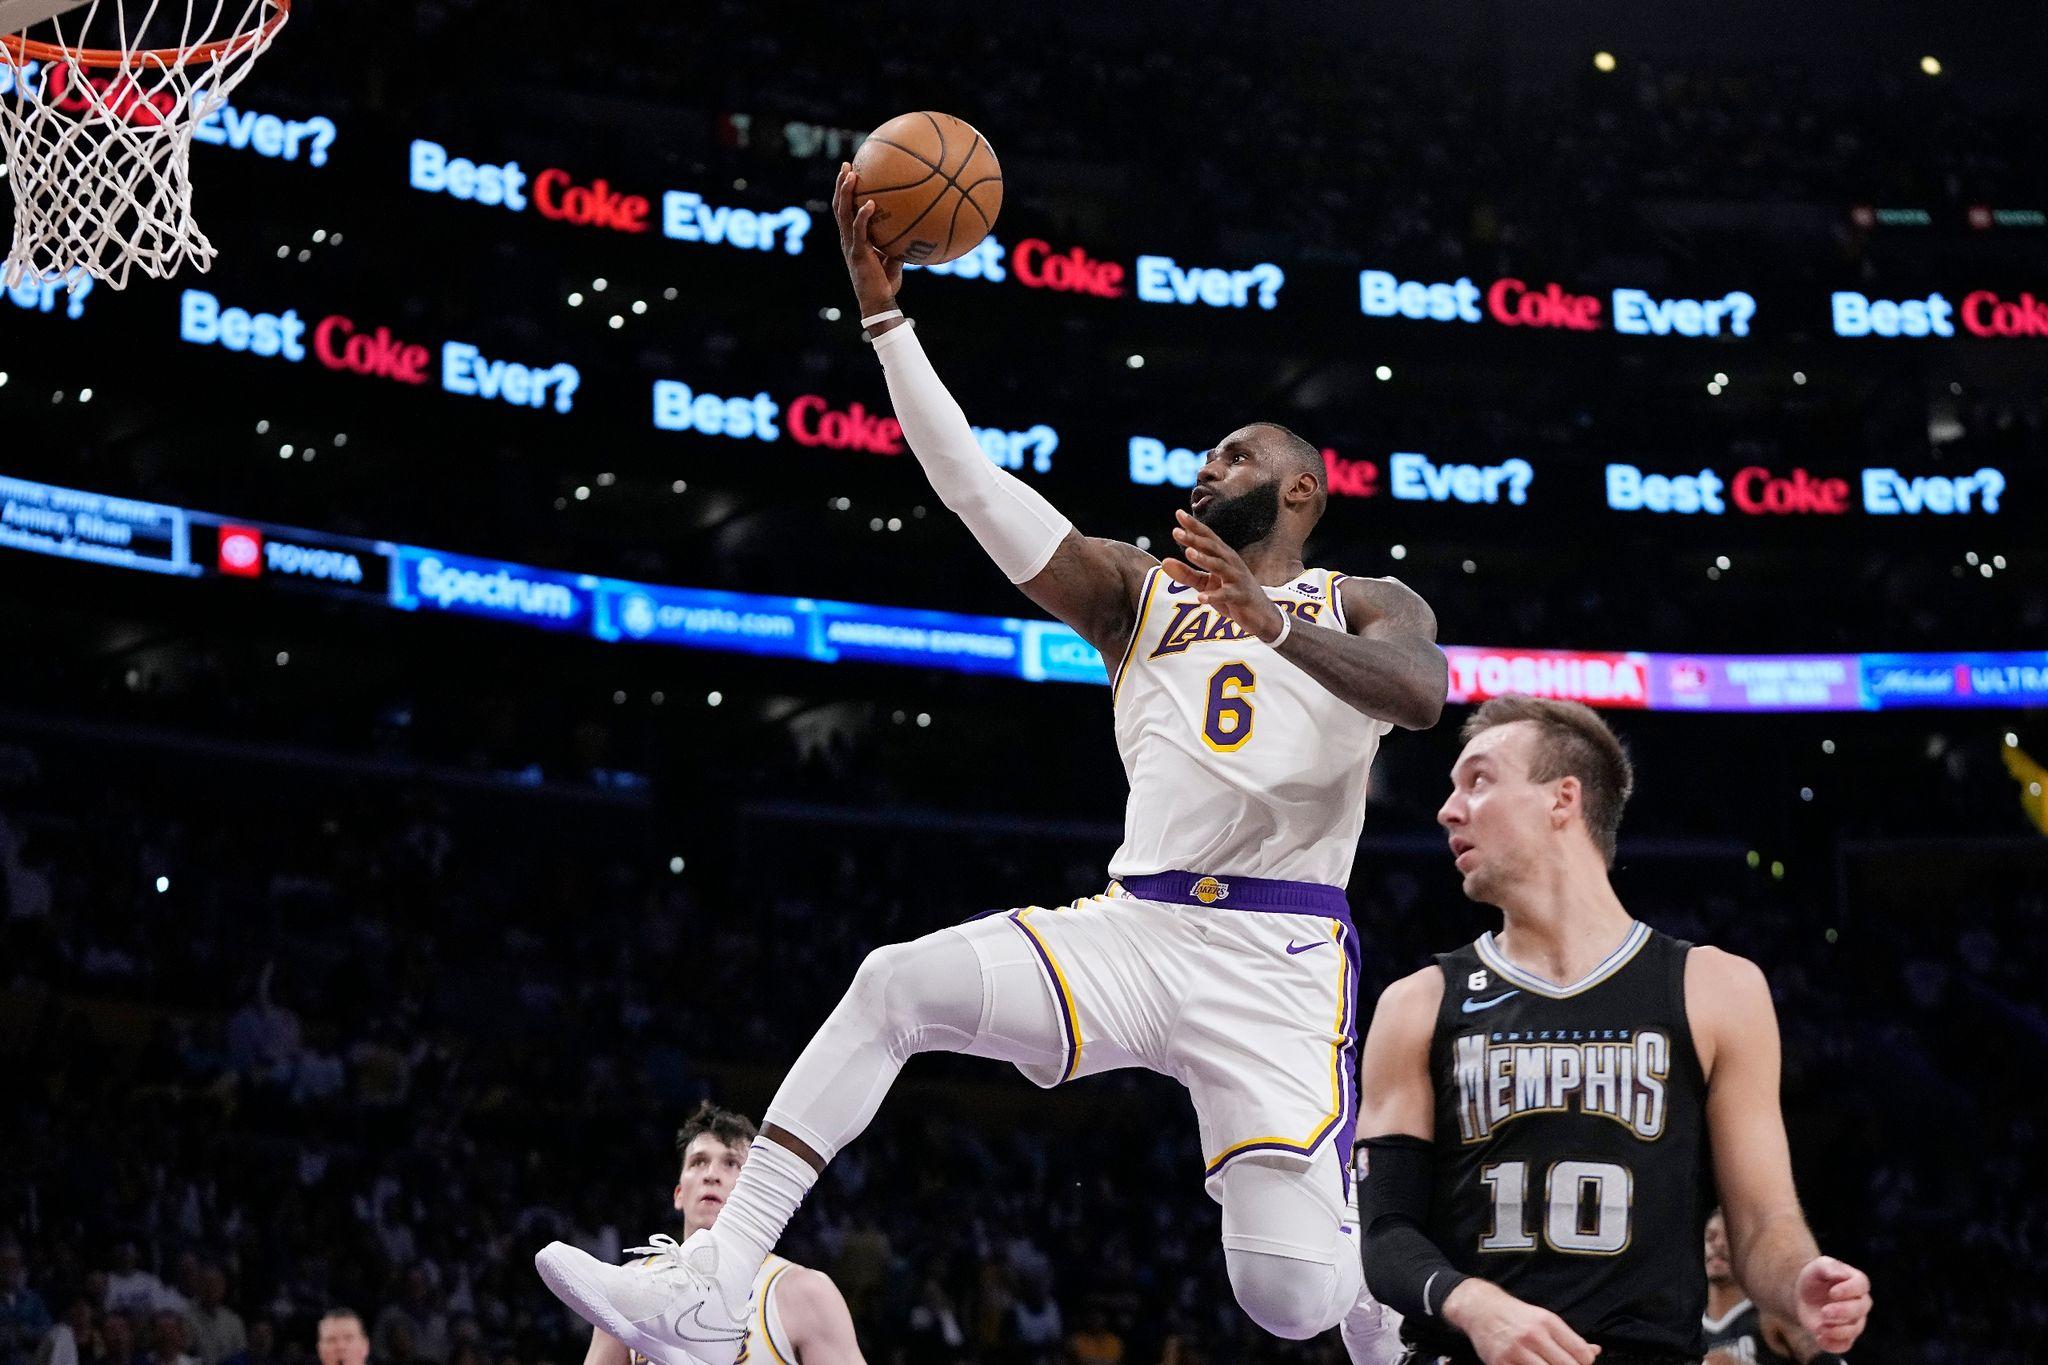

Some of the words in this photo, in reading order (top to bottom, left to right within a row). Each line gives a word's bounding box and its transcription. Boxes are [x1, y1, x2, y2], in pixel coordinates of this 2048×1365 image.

[410, 139, 527, 211] Best
[534, 169, 649, 232] Coke
[663, 190, 811, 255] Ever?
[902, 235, 1006, 282] st
[1013, 239, 1123, 297] Coke
[1136, 255, 1284, 309] Ever?
[1357, 270, 1482, 323] Best
[1488, 279, 1600, 330] Coke
[1612, 288, 1756, 337] Ever?
[1831, 291, 1955, 337] Best
[1962, 290, 2048, 337] Cok
[180, 289, 305, 362] Best
[315, 316, 429, 383] Coke
[442, 341, 580, 413] Ever?
[653, 380, 779, 441] Best
[788, 396, 903, 454] Coke
[969, 425, 1059, 473] er?
[1129, 436, 1208, 490] Be
[1322, 449, 1377, 496] ke
[1390, 453, 1534, 505] Ever?
[1605, 464, 1725, 514] Best
[1732, 467, 1848, 513] Coke
[1862, 468, 2006, 514] Ever?
[266, 542, 362, 583] TOYOTA
[418, 557, 572, 619] Spectrum
[1148, 600, 1322, 661] LAKS
[1201, 660, 1256, 752] 6
[1452, 655, 1643, 699] TOSHIBA
[1467, 969, 1487, 991] 6
[1492, 1030, 1629, 1041] GRIZZLIES
[1453, 1031, 1670, 1144] MEMPHIS
[1478, 1160, 1633, 1256] 10
